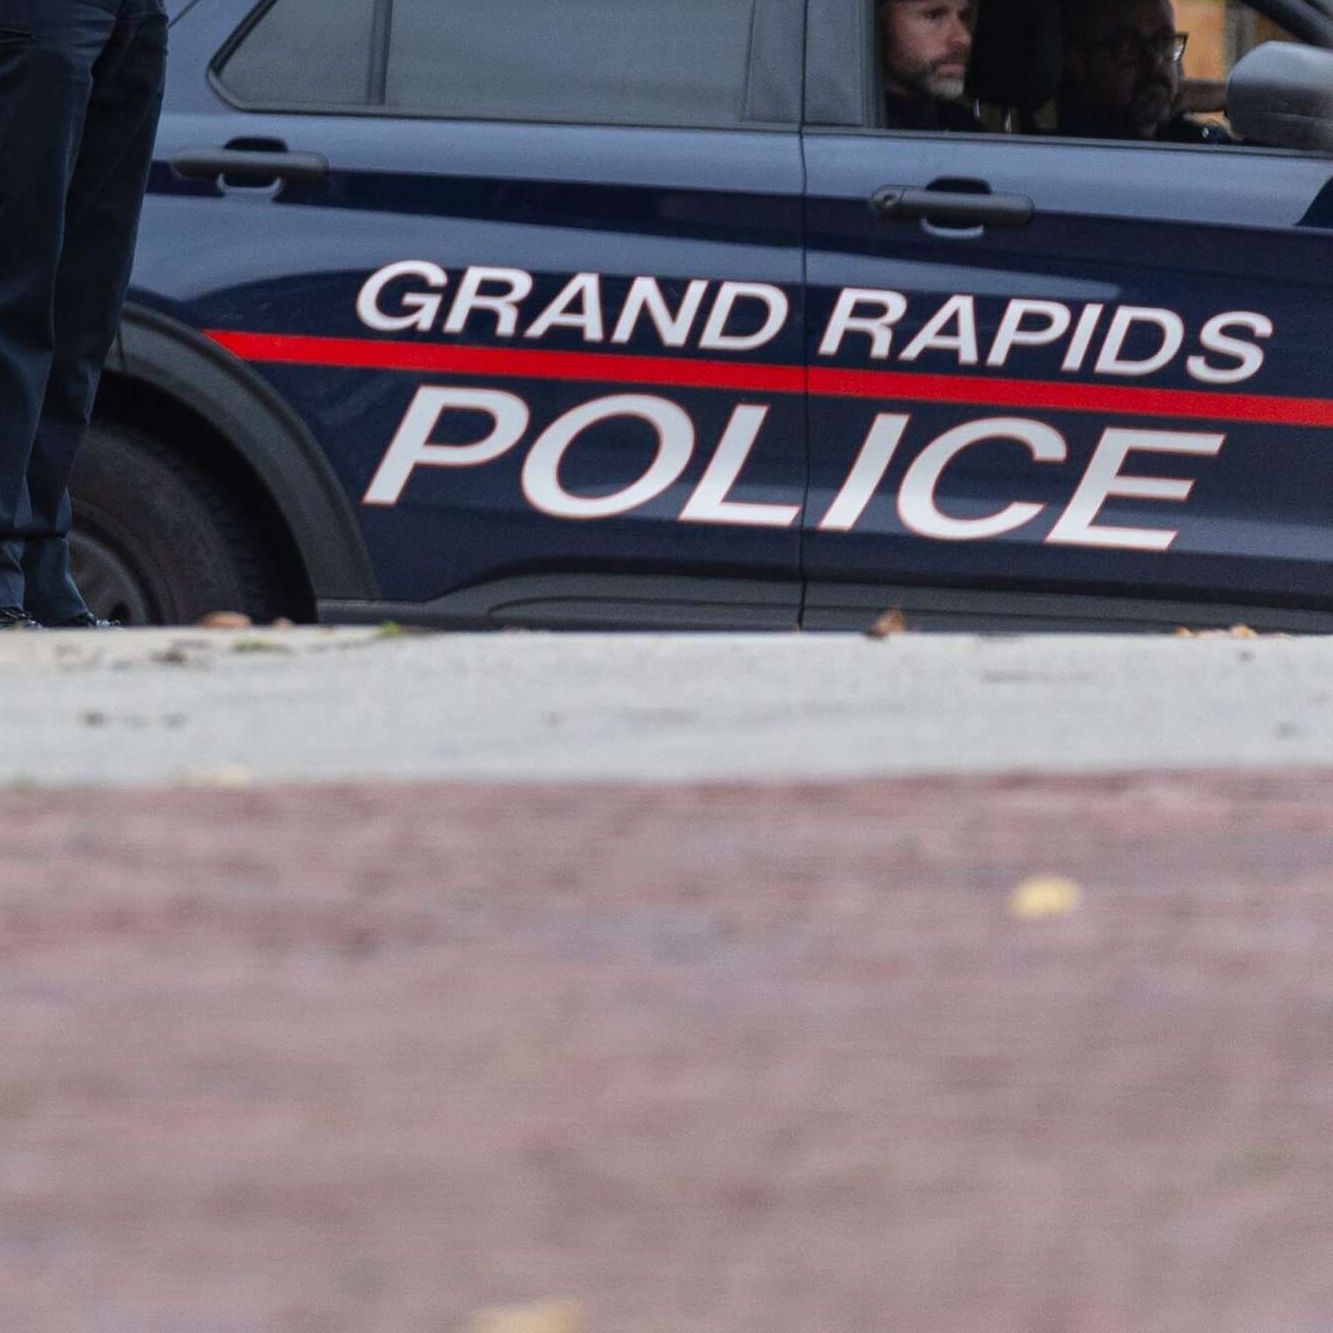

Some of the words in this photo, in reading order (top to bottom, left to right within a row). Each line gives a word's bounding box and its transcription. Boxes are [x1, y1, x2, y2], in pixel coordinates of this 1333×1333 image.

[355, 259, 788, 351] GRAND
[817, 286, 1275, 385] RAPIDS
[361, 384, 1226, 550] POLICE
